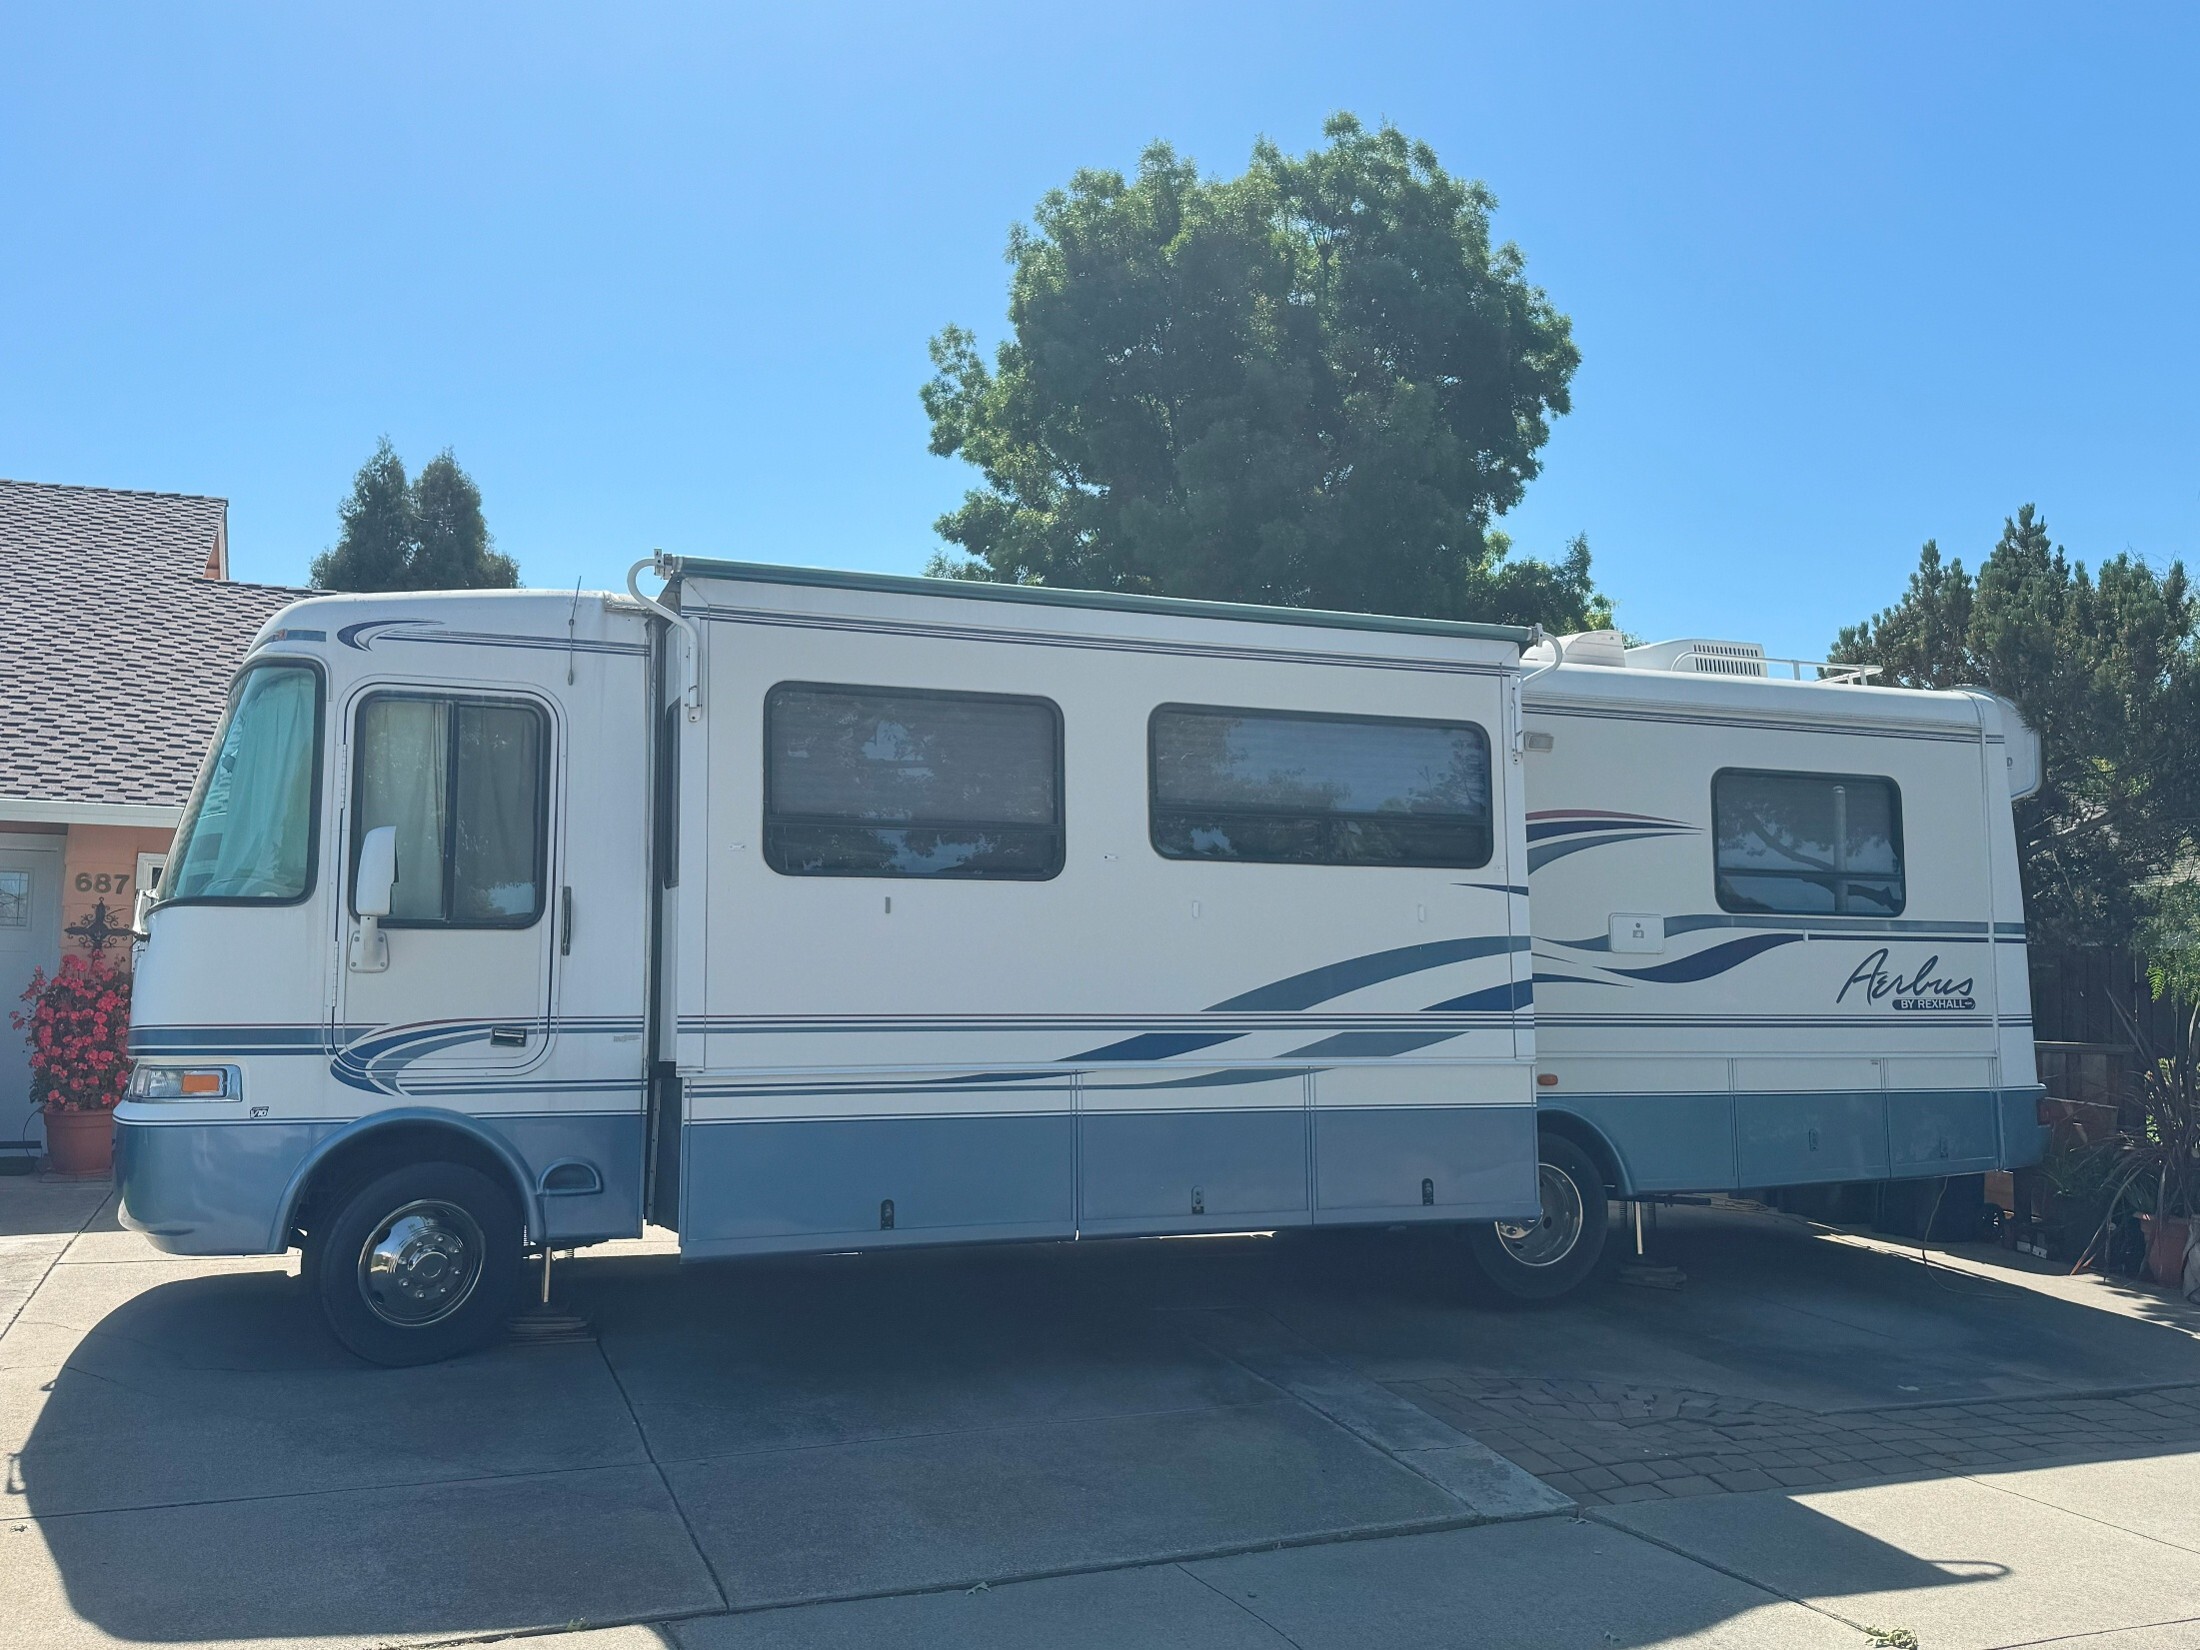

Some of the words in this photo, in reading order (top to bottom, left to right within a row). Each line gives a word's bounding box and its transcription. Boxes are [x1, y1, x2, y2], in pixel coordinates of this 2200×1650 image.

[75, 872, 130, 895] 687
[1836, 948, 1973, 1006] Aerbus
[1900, 999, 1915, 1009] BY
[1917, 999, 1966, 1009] REXHALL
